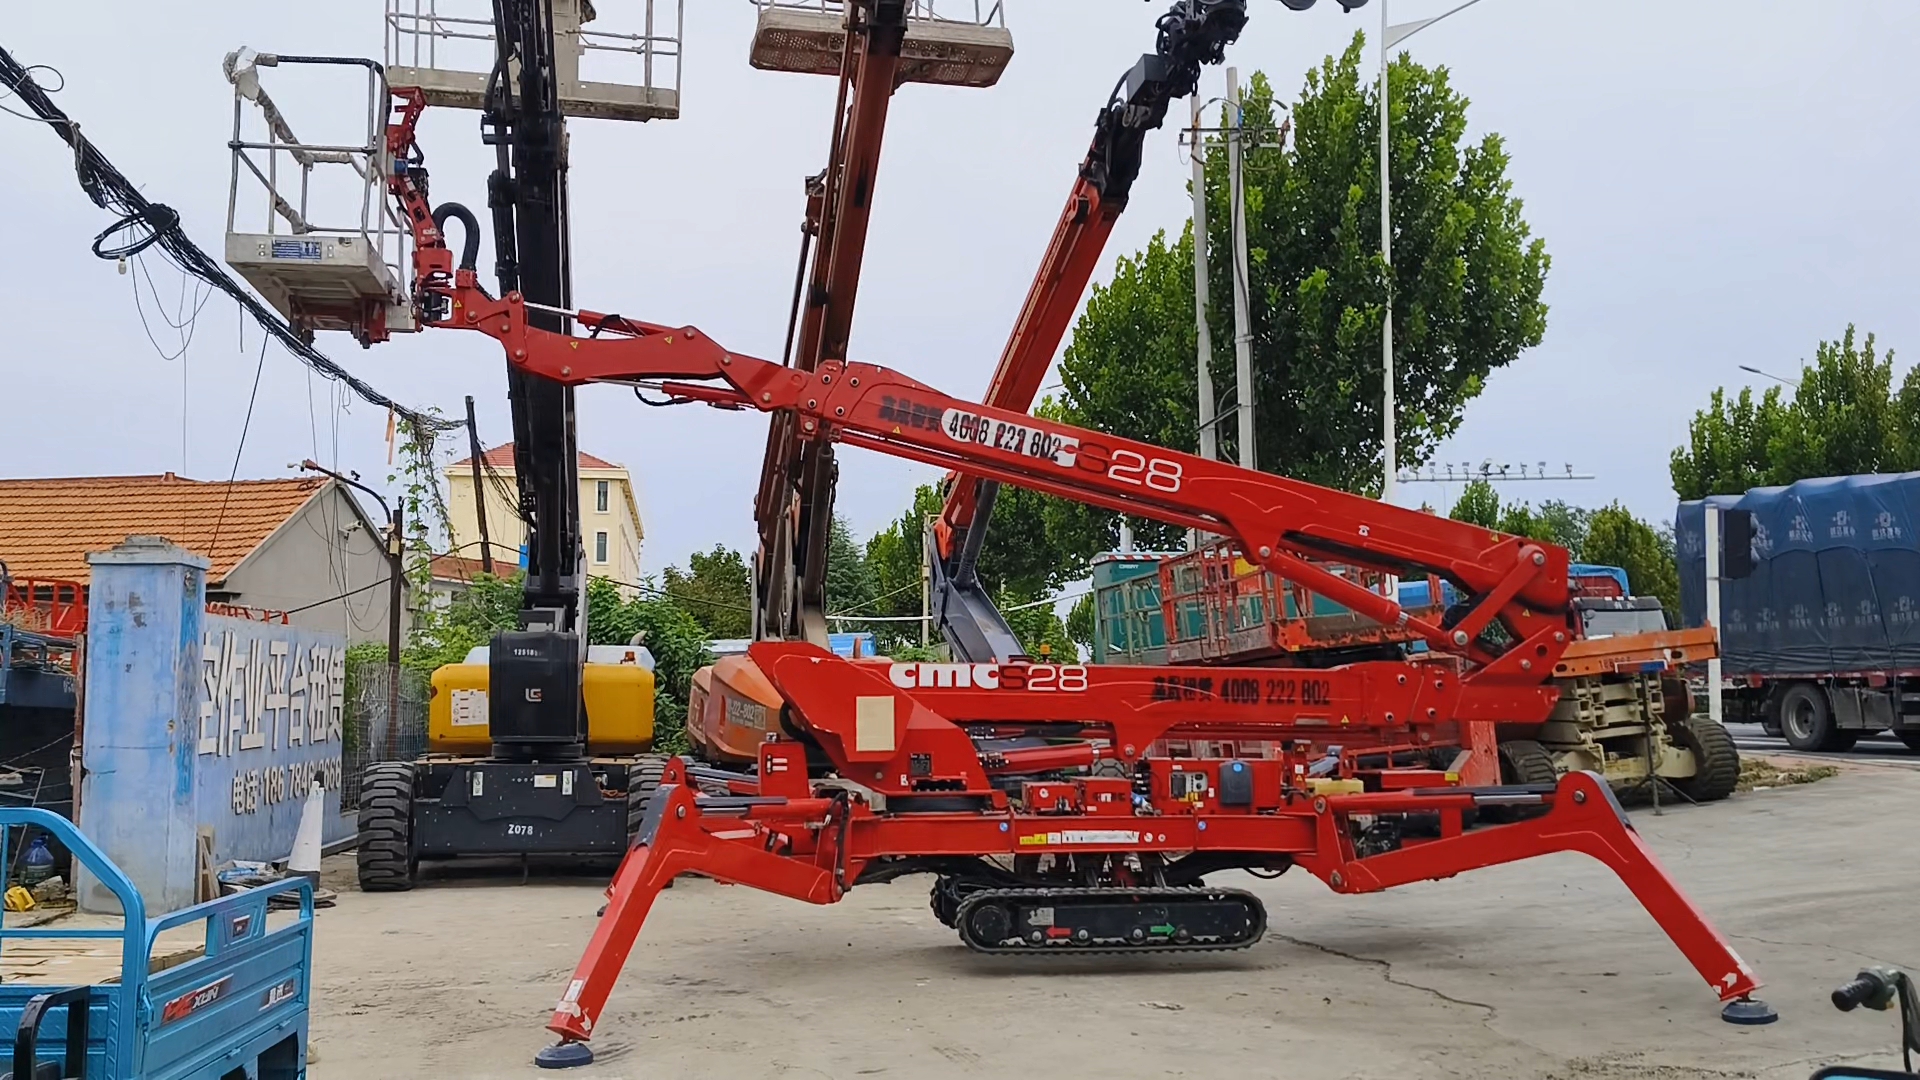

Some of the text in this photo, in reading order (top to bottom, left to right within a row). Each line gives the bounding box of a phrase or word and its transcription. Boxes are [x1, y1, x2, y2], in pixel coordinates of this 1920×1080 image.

[949, 412, 1062, 462] 4008 222 802
[1077, 442, 1183, 493] S28
[889, 664, 1088, 691] cmc S28
[1221, 678, 1331, 706] 4008 222 802
[508, 824, 533, 835] Z078
